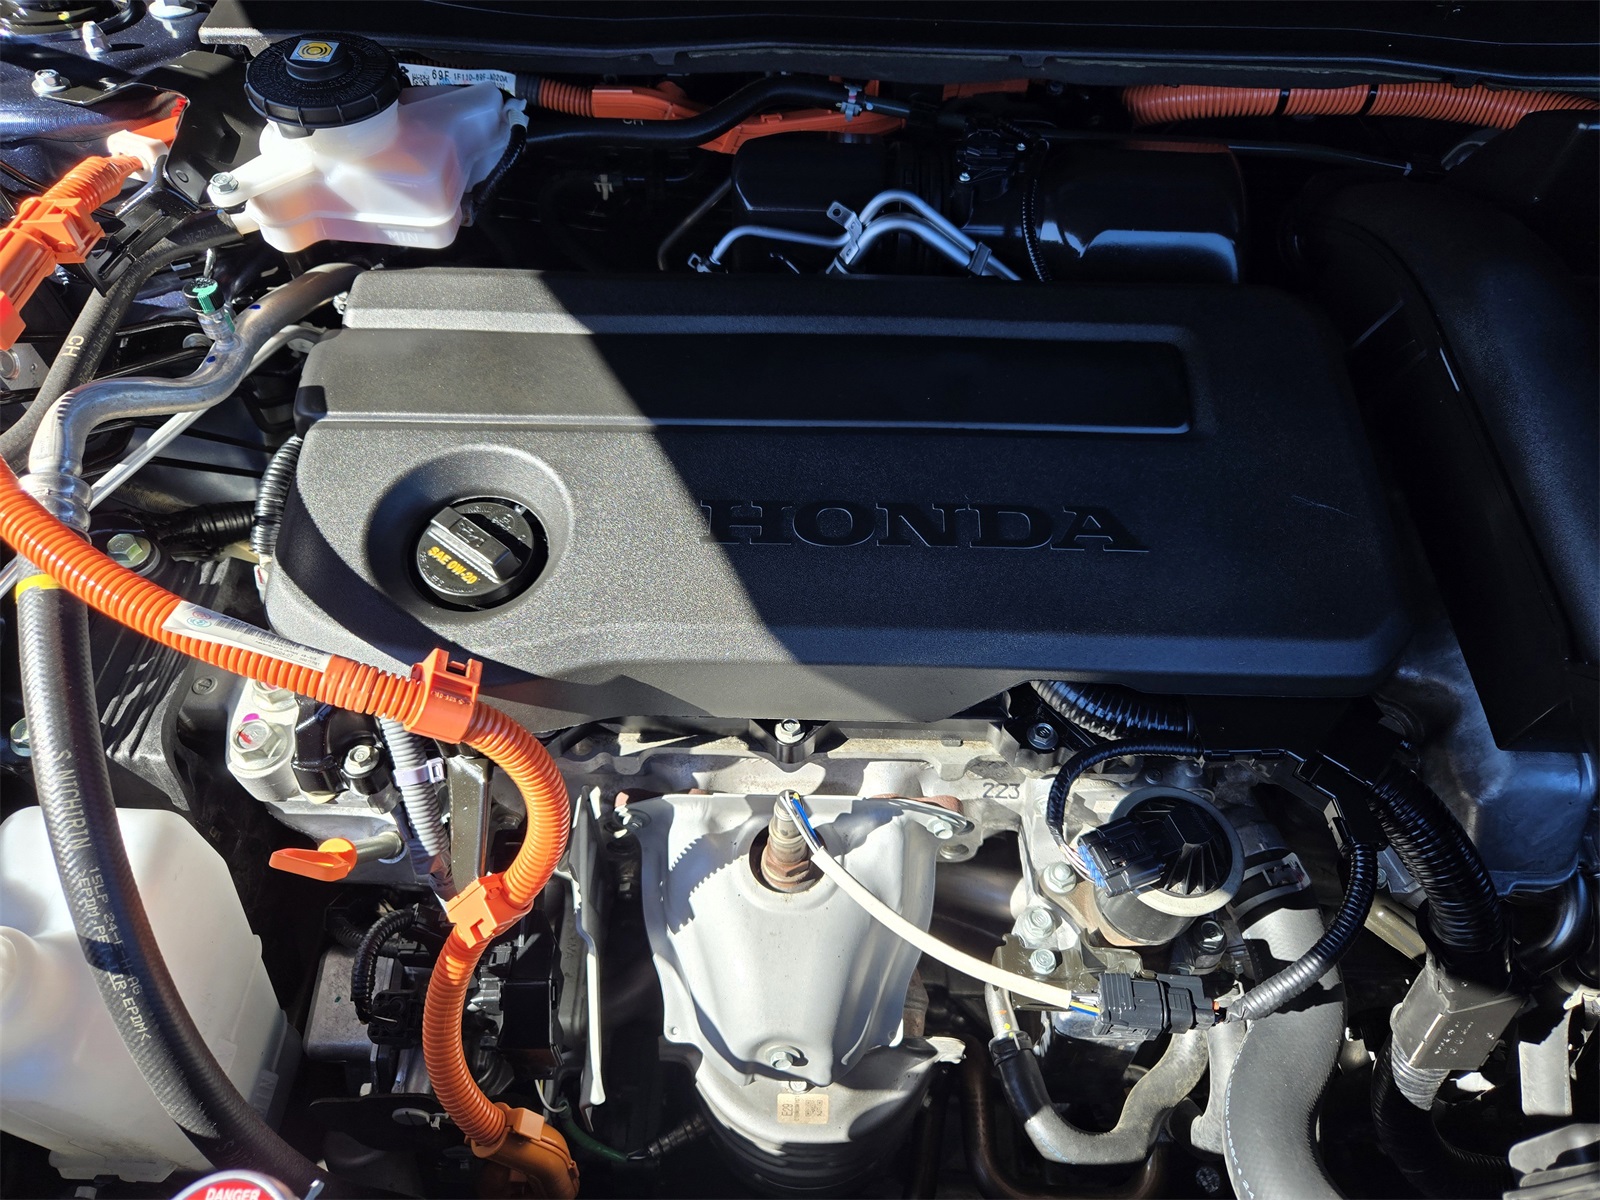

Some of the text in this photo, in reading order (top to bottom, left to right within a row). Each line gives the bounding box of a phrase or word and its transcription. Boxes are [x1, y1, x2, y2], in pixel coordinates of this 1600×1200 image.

[385, 229, 419, 243] MIN
[61, 335, 84, 357] CH
[700, 500, 1149, 552] HONDA
[427, 546, 452, 566] SAE
[446, 560, 478, 585] 0W-20
[982, 782, 1020, 799] 223
[205, 1187, 261, 1200] DANGER
